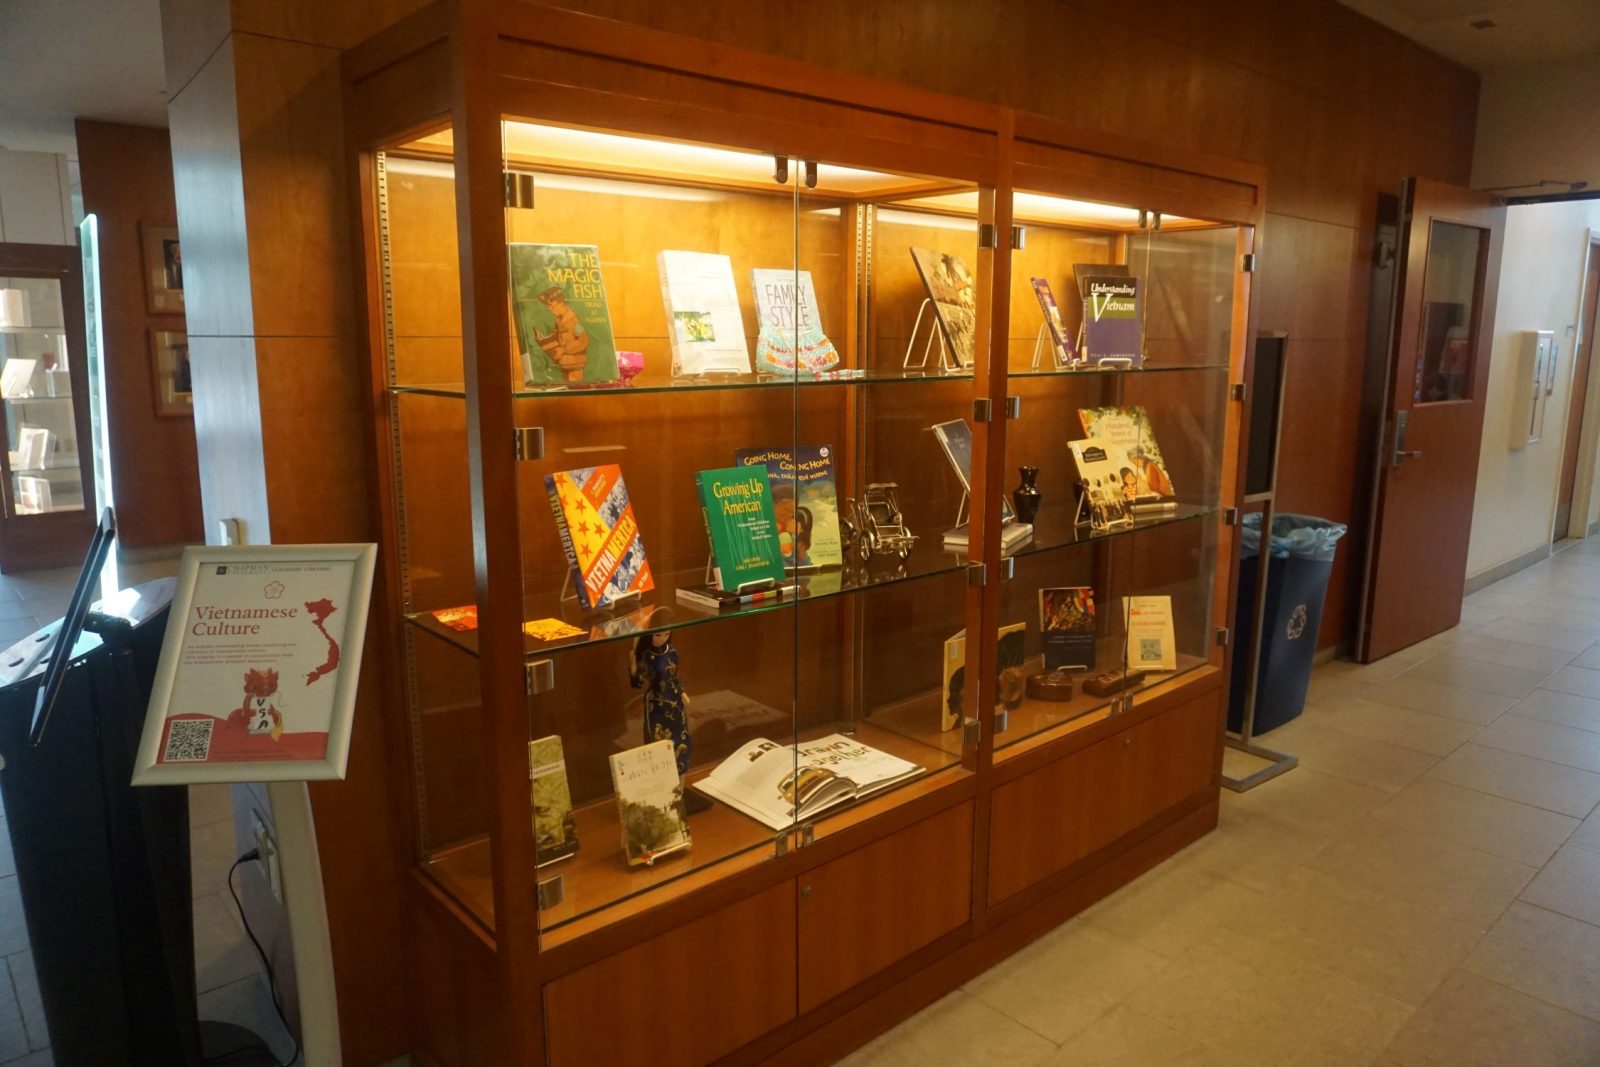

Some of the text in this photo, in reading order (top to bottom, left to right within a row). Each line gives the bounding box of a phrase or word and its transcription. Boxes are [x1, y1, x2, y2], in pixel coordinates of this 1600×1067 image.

[566, 252, 597, 268] THE
[545, 267, 601, 283] MAGIC
[572, 283, 604, 299] FISH
[765, 284, 806, 306] FAMIY
[1091, 282, 1136, 296] Understanding
[1090, 292, 1135, 323] Vietnam
[770, 305, 810, 328] STYE
[744, 455, 767, 466] GOING
[780, 457, 831, 471] COMNG HOME
[713, 478, 763, 499] Growing Up
[724, 499, 761, 516] American
[584, 513, 637, 593] VIETNAMERICA
[195, 605, 298, 620] Vietnamese
[192, 621, 260, 636] Culture
